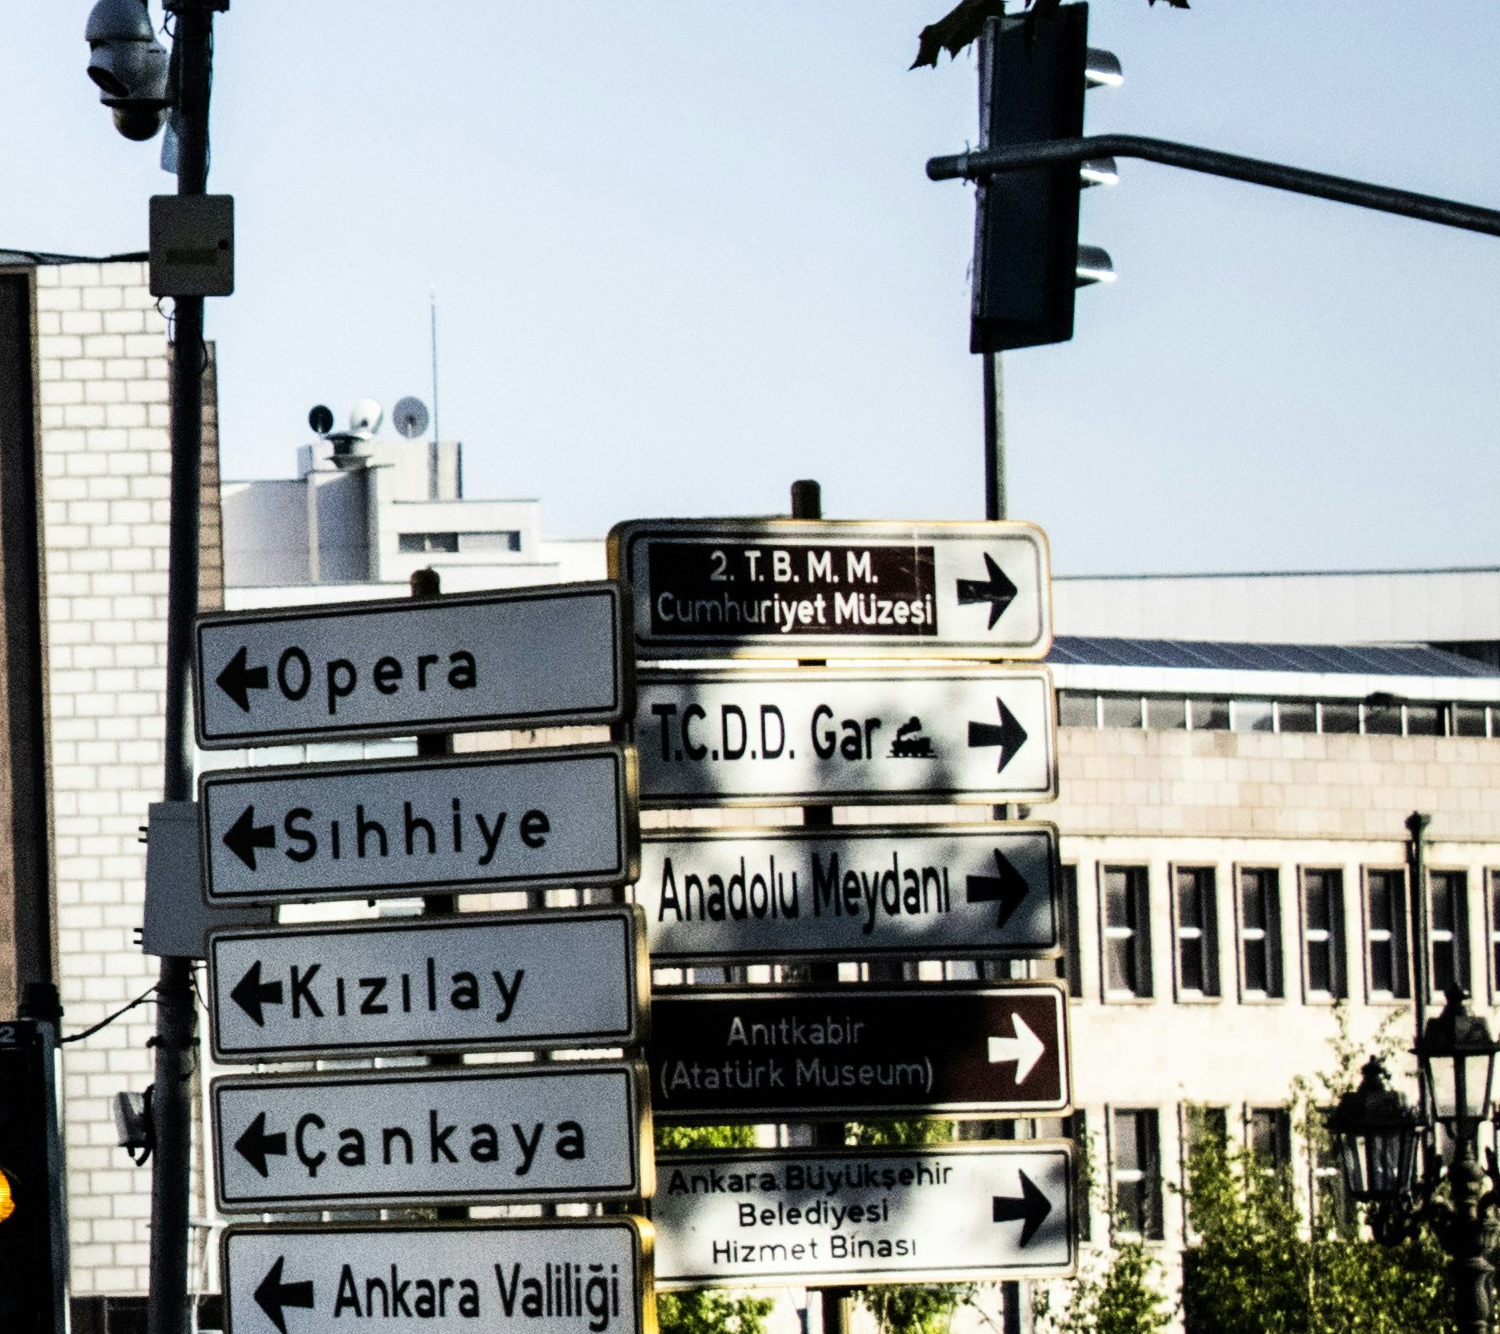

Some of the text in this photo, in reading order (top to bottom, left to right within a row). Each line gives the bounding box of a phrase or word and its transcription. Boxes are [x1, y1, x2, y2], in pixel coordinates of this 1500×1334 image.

[710, 550, 879, 583] 2. T. B. M. M.
[656, 591, 934, 633] Cumhuriyet Müzesi
[276, 646, 478, 715] Opera
[650, 703, 882, 762] T.C.D.D. Gar
[283, 797, 551, 867] Sıhhiye
[658, 851, 951, 935] Anadolu Meydanı
[289, 956, 526, 1023] Kızılay
[726, 1015, 866, 1047] Anıtkabir
[660, 1056, 935, 1099] (Atatürk Museum)
[294, 1109, 586, 1178] Çankaya
[667, 1163, 955, 1196] Ankara Büyükşehir
[738, 1198, 890, 1233] Belediyesi
[711, 1233, 917, 1265] Hizmet Binası
[333, 1262, 620, 1333] Ankara Valiliği
